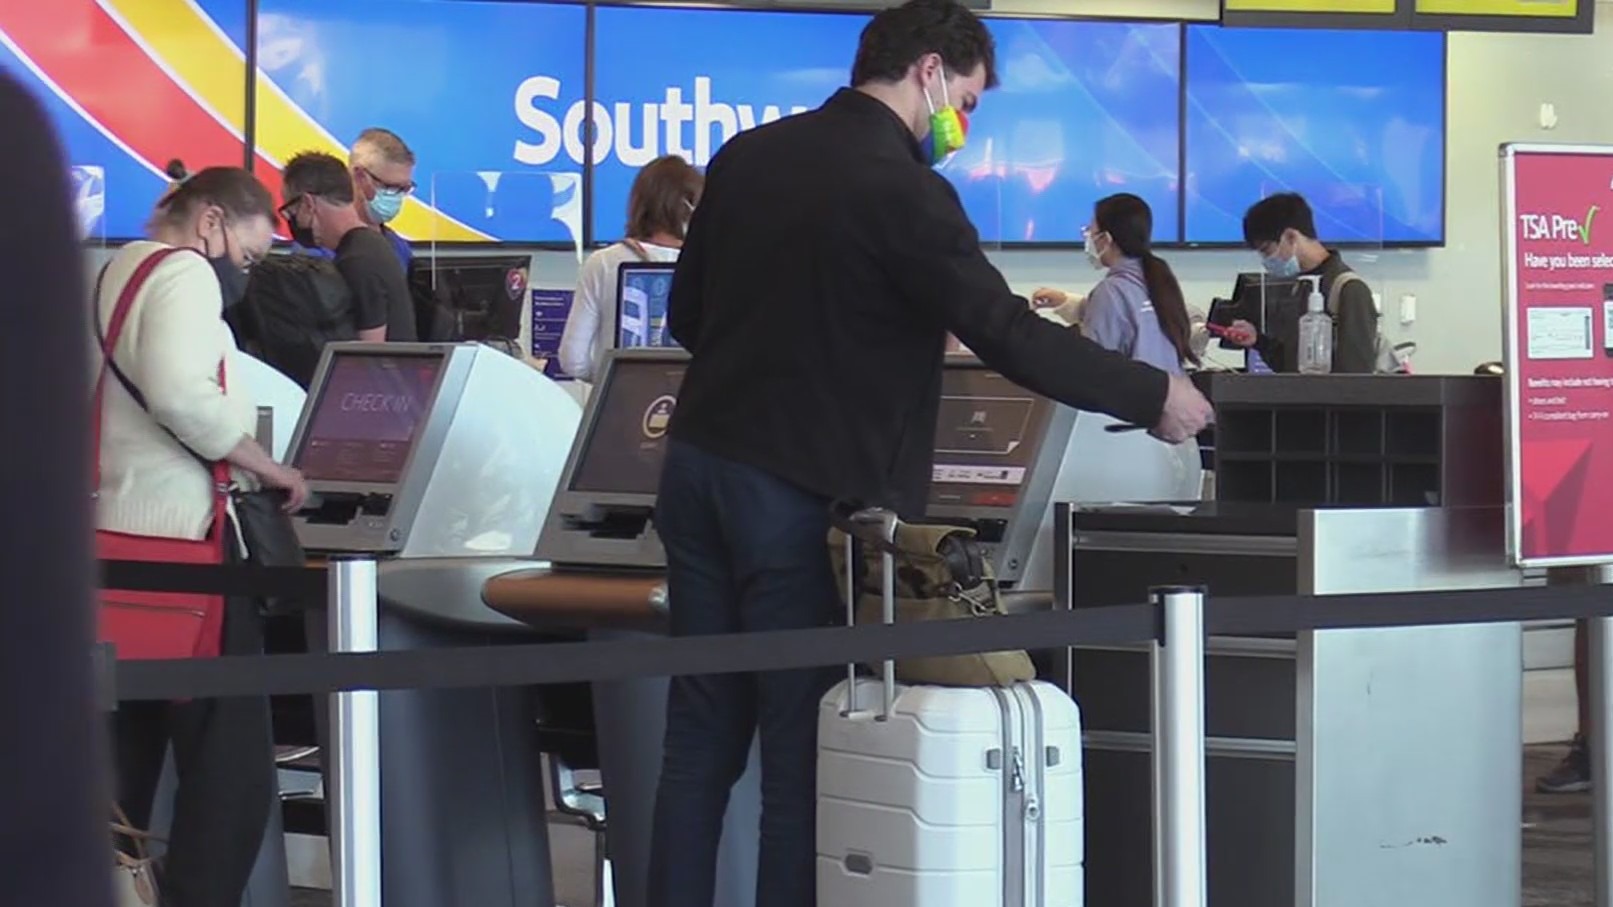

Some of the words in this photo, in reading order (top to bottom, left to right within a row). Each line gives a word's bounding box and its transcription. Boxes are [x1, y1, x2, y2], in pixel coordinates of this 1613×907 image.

[1519, 214, 1551, 240] TSA
[1552, 214, 1578, 240] Pre
[1524, 252, 1548, 268] Have
[1549, 256, 1566, 271] you
[1567, 252, 1590, 268] been
[512, 273, 522, 290] 2
[341, 392, 395, 412] CHECK
[394, 395, 415, 412] IN
